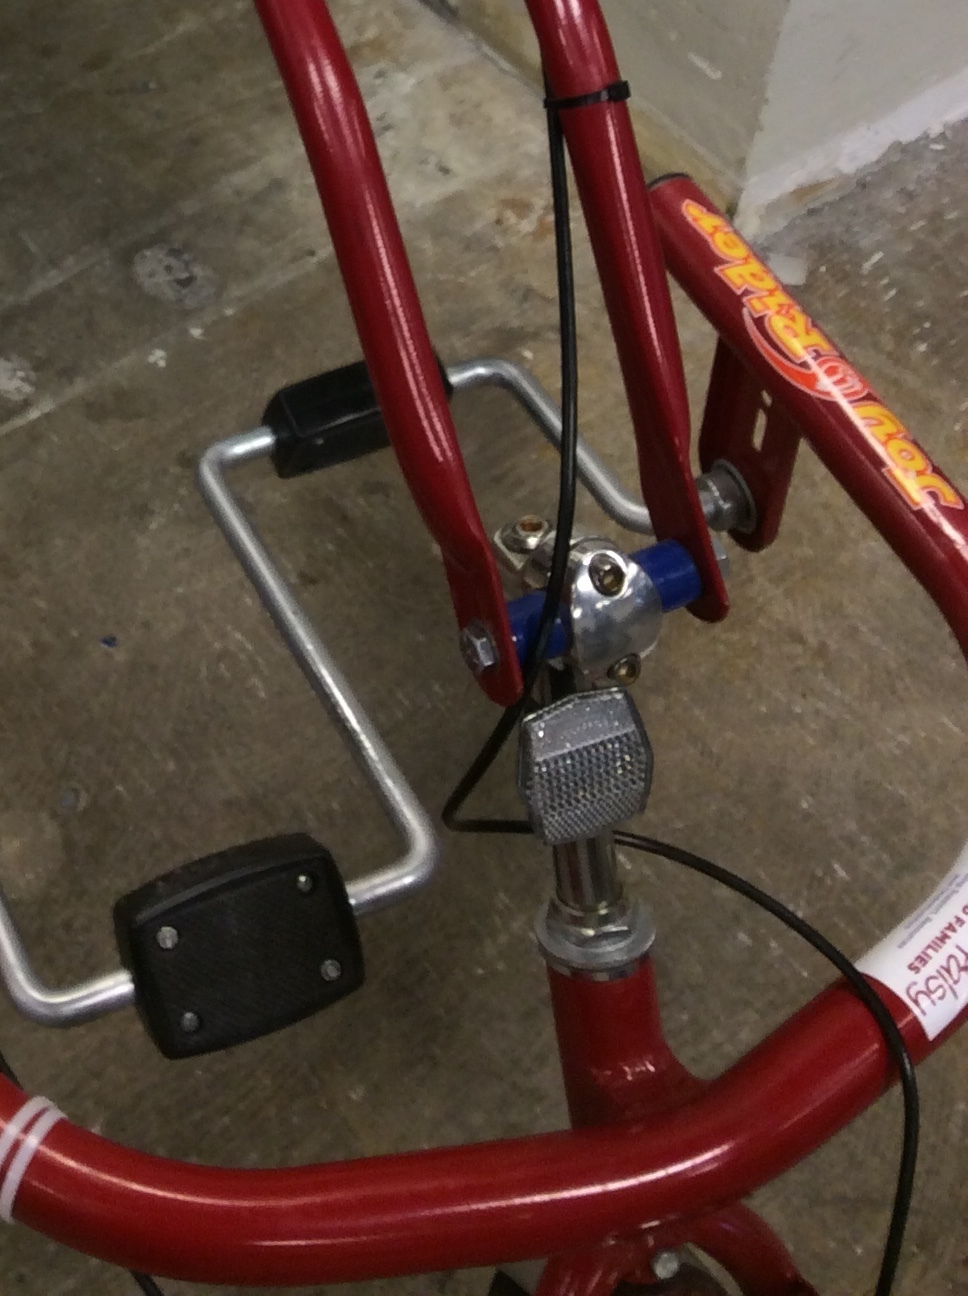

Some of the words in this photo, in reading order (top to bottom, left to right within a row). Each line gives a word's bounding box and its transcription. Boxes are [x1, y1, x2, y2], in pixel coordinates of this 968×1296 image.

[682, 199, 840, 363] Rider
[851, 401, 964, 510] Joy
[907, 915, 965, 974] FAMILIES
